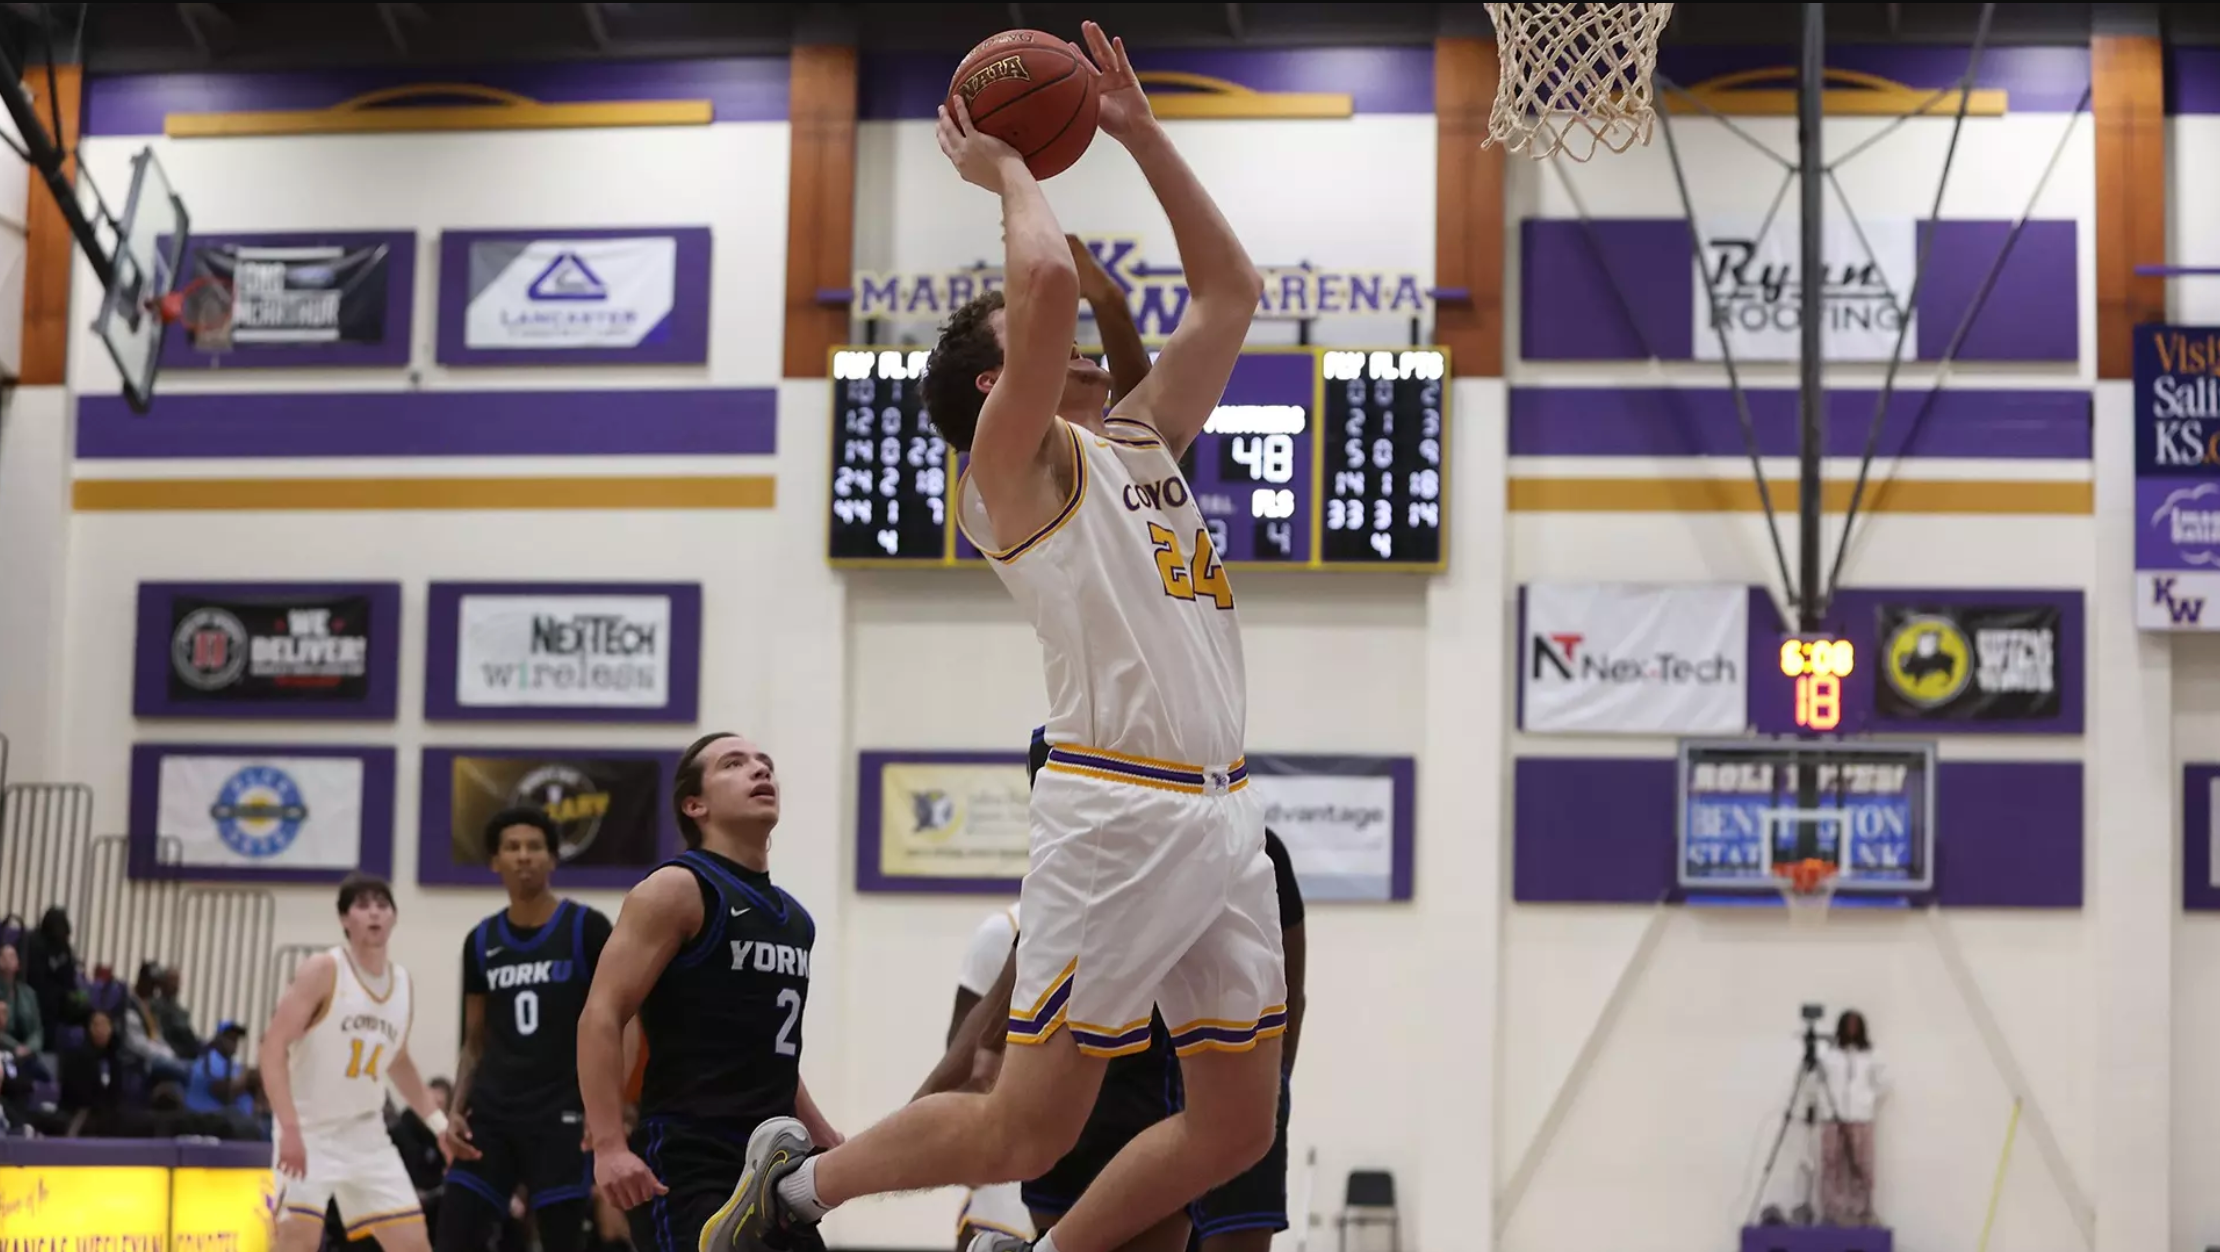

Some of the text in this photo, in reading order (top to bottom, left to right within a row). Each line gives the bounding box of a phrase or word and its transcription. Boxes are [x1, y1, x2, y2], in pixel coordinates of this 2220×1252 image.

[959, 55, 1031, 109] NAIA
[1709, 238, 1889, 304] Ryn
[1709, 302, 1905, 333] ROOING
[2154, 331, 2220, 373] Visi
[1420, 379, 1440, 406] 2
[2153, 374, 2220, 418] Sali
[846, 407, 875, 436] 12
[881, 407, 901, 436] 0
[1345, 408, 1440, 437] 2 1 3
[845, 437, 945, 467] 14 0 22
[1231, 434, 1293, 483] 48
[1345, 438, 1439, 469] 5 0 9
[835, 466, 873, 497] 24
[879, 466, 899, 497] 2
[1123, 476, 1193, 512] COYO
[1335, 471, 1365, 496] 14
[1381, 471, 1392, 496] 1
[834, 497, 944, 525] 44 1 7
[1327, 499, 1438, 530] 33 3 14
[877, 529, 899, 555] 4
[1267, 522, 1291, 555] 4
[1370, 532, 1392, 559] 4
[1147, 521, 1234, 610] 24
[288, 609, 331, 634] WE
[1796, 674, 1841, 731] 18
[1266, 803, 1385, 832] dvantage
[1689, 842, 1768, 867] STAT
[730, 940, 810, 978] YORK
[515, 991, 538, 1036] 0
[775, 988, 801, 1056] 2
[346, 1038, 384, 1082] 14
